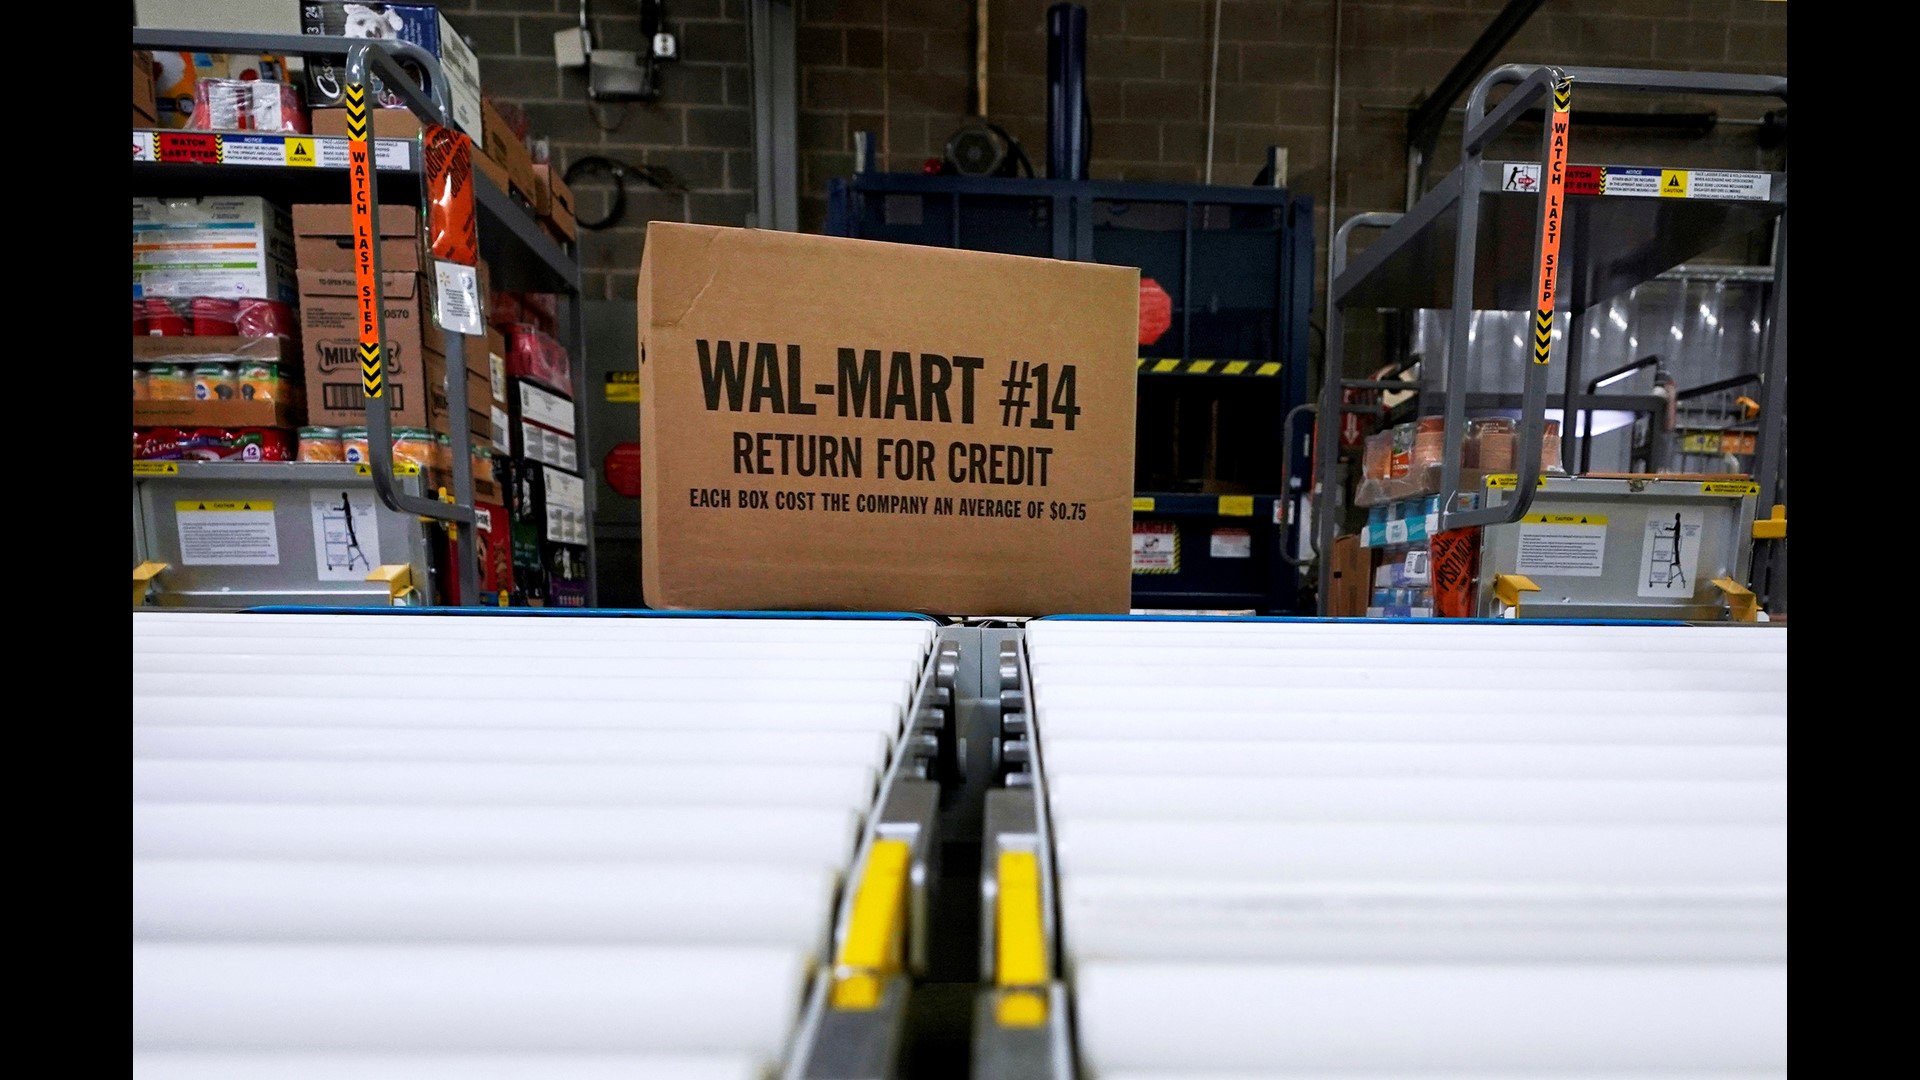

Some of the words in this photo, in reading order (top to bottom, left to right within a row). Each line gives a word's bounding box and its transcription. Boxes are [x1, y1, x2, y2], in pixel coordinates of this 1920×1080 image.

[161, 149, 188, 157] LAST
[190, 150, 215, 159] STEP
[170, 138, 206, 147] WATCH
[1551, 122, 1567, 185] WATCH
[352, 151, 367, 215] WATCH
[1576, 182, 1600, 190] STEP
[1548, 195, 1559, 244] LAST
[359, 225, 369, 275] LAST
[1542, 254, 1554, 302] STEP
[362, 285, 374, 335] STEP
[696, 338, 984, 426] WAL-MART
[998, 359, 1081, 432] #14
[732, 431, 863, 479] RETURN
[876, 437, 936, 482] FOR
[947, 441, 1053, 487] CREDIT
[689, 487, 731, 509] EACH
[737, 489, 769, 510] BOX
[775, 491, 816, 512] COST
[821, 492, 850, 513] THE
[856, 494, 929, 515] COMPANY
[933, 496, 954, 517] AN
[958, 498, 1022, 519] AVERAGE
[1027, 500, 1045, 520] OF
[1049, 501, 1087, 522] $0.75
[1436, 557, 1463, 592] PISO
